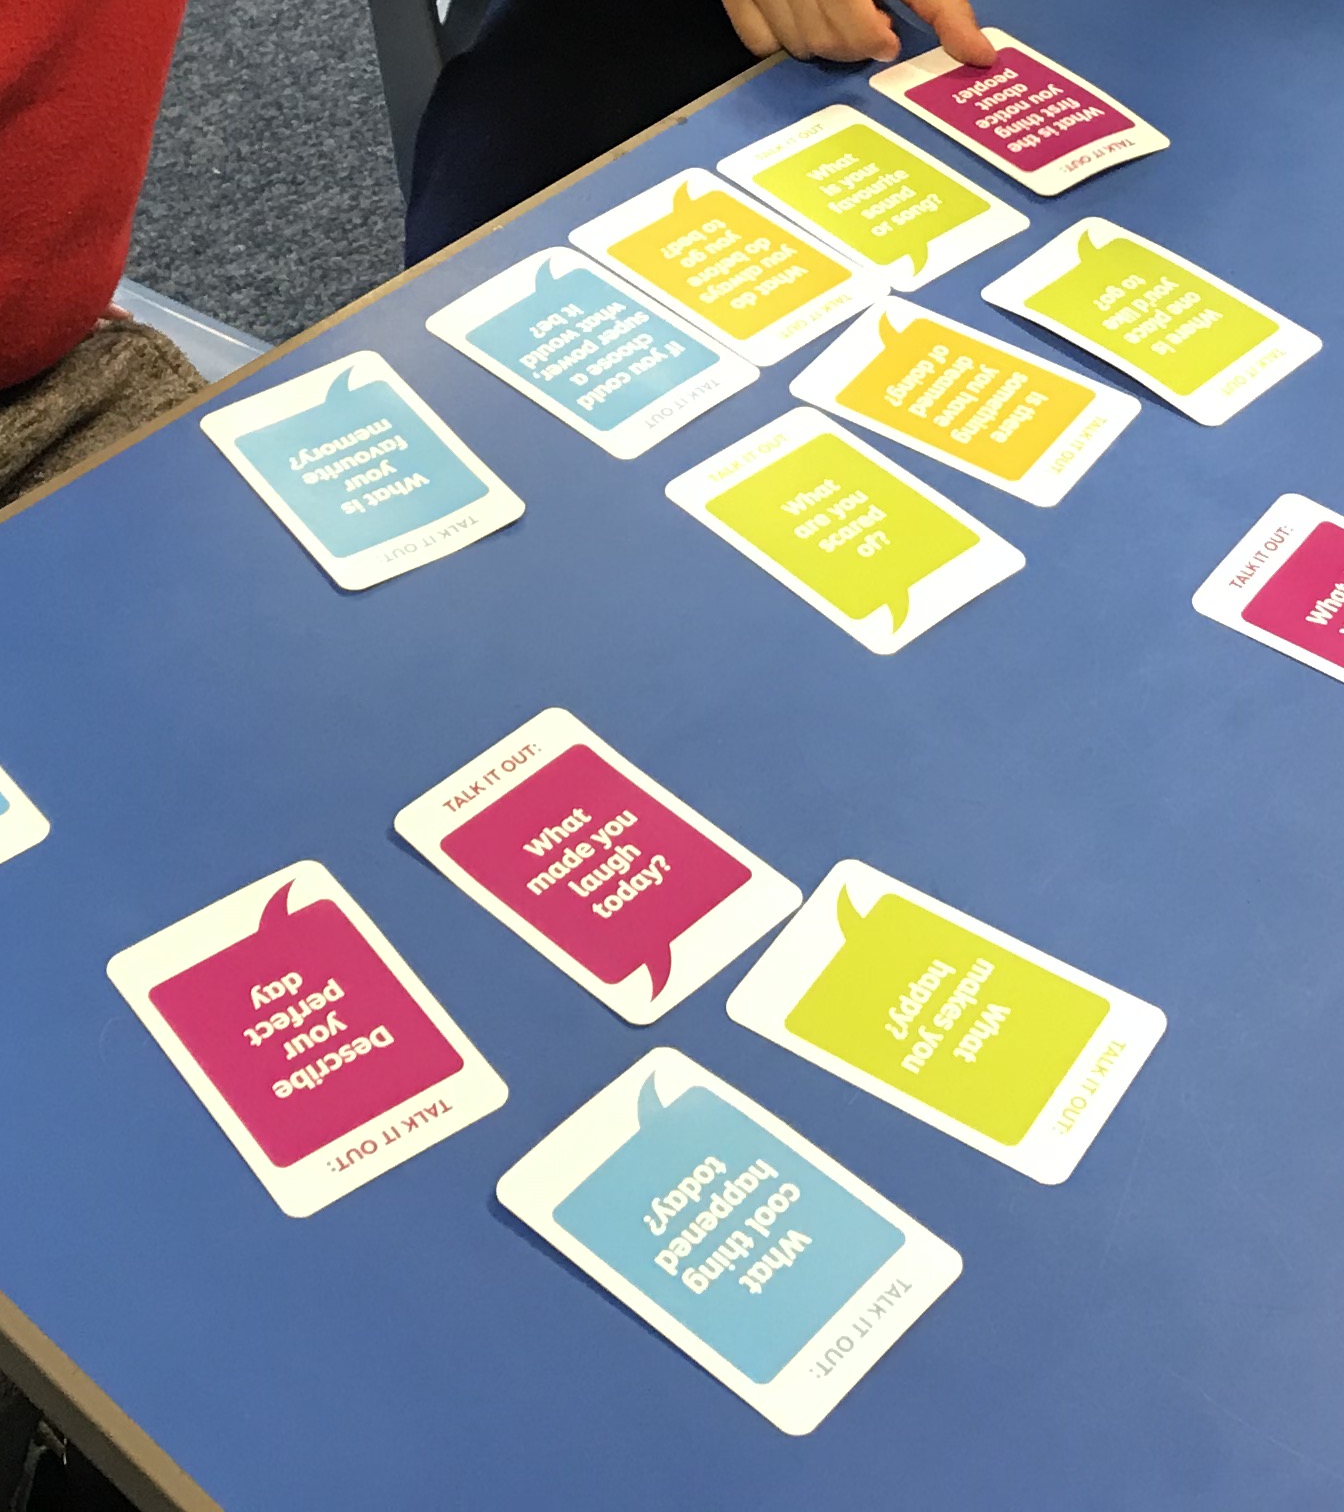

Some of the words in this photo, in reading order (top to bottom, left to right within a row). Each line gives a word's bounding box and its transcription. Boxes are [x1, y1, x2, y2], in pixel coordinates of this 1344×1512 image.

[952, 68, 1019, 104] people?
[974, 83, 1028, 111] about
[1028, 83, 1064, 104] you
[975, 100, 1031, 129] notice
[1040, 97, 1081, 118] first
[1053, 106, 1105, 131] What
[994, 113, 1044, 139] thing
[1007, 134, 1041, 153] the
[1038, 125, 1060, 138] is
[1092, 149, 1106, 159] IT
[1103, 139, 1136, 153] TALK
[806, 154, 859, 181] What
[820, 184, 842, 197] is
[838, 163, 879, 190] your
[827, 170, 909, 214] favourite
[861, 185, 916, 220] sound
[1093, 285, 1126, 311] go?
[1121, 275, 1146, 290] to
[1131, 276, 1179, 313] you'd
[560, 303, 584, 317] it
[575, 302, 626, 333] what
[1102, 306, 1141, 330] like
[1166, 292, 1201, 315] one
[529, 313, 568, 339] be?
[597, 311, 650, 346] super
[1124, 309, 1172, 344] place
[1165, 309, 1223, 345] Where
[519, 329, 581, 370] would
[533, 339, 600, 381] power,
[628, 347, 668, 375] you
[664, 341, 686, 358] If
[1151, 340, 1176, 355] is
[569, 373, 588, 386] a
[576, 372, 632, 411] could
[289, 419, 392, 471] memory?
[302, 435, 408, 484] favourite
[344, 459, 397, 492] your
[363, 473, 430, 506] What
[340, 499, 366, 514] is
[781, 479, 841, 515] What
[794, 513, 831, 539] are
[827, 490, 868, 520] you
[422, 535, 437, 547] IT
[438, 516, 479, 539] TALK
[819, 504, 887, 553] scared
[857, 531, 890, 557] of?
[1228, 561, 1260, 589] TALK
[1253, 550, 1269, 563] IT
[1262, 524, 1293, 552] OUT:
[442, 781, 486, 812] TALK
[482, 768, 501, 785] IT
[498, 741, 543, 774] OUT:
[523, 808, 592, 856] What
[527, 842, 595, 895] made
[590, 810, 638, 850] you
[568, 844, 641, 897] laugh
[592, 854, 671, 918] today?
[251, 972, 303, 1010] day
[885, 960, 956, 1040] happy?
[933, 958, 995, 1031] makes
[243, 978, 345, 1046] perfect
[283, 1010, 348, 1060] your
[901, 1025, 944, 1074] you
[953, 1003, 1011, 1062] What
[272, 1025, 394, 1098] Describe
[1091, 1040, 1126, 1077] TALK
[1081, 1077, 1100, 1096] IT
[401, 1099, 453, 1133] TALK
[382, 1126, 401, 1145] IT
[325, 1137, 380, 1175] OUT:
[643, 1156, 727, 1236] today?
[744, 1183, 801, 1238] cool
[654, 1159, 779, 1276] happened
[682, 1230, 754, 1294] thing
[739, 1230, 812, 1294] What
[867, 1279, 912, 1319] TALK
[852, 1317, 873, 1338] IT
[806, 1333, 857, 1381] OUT:
